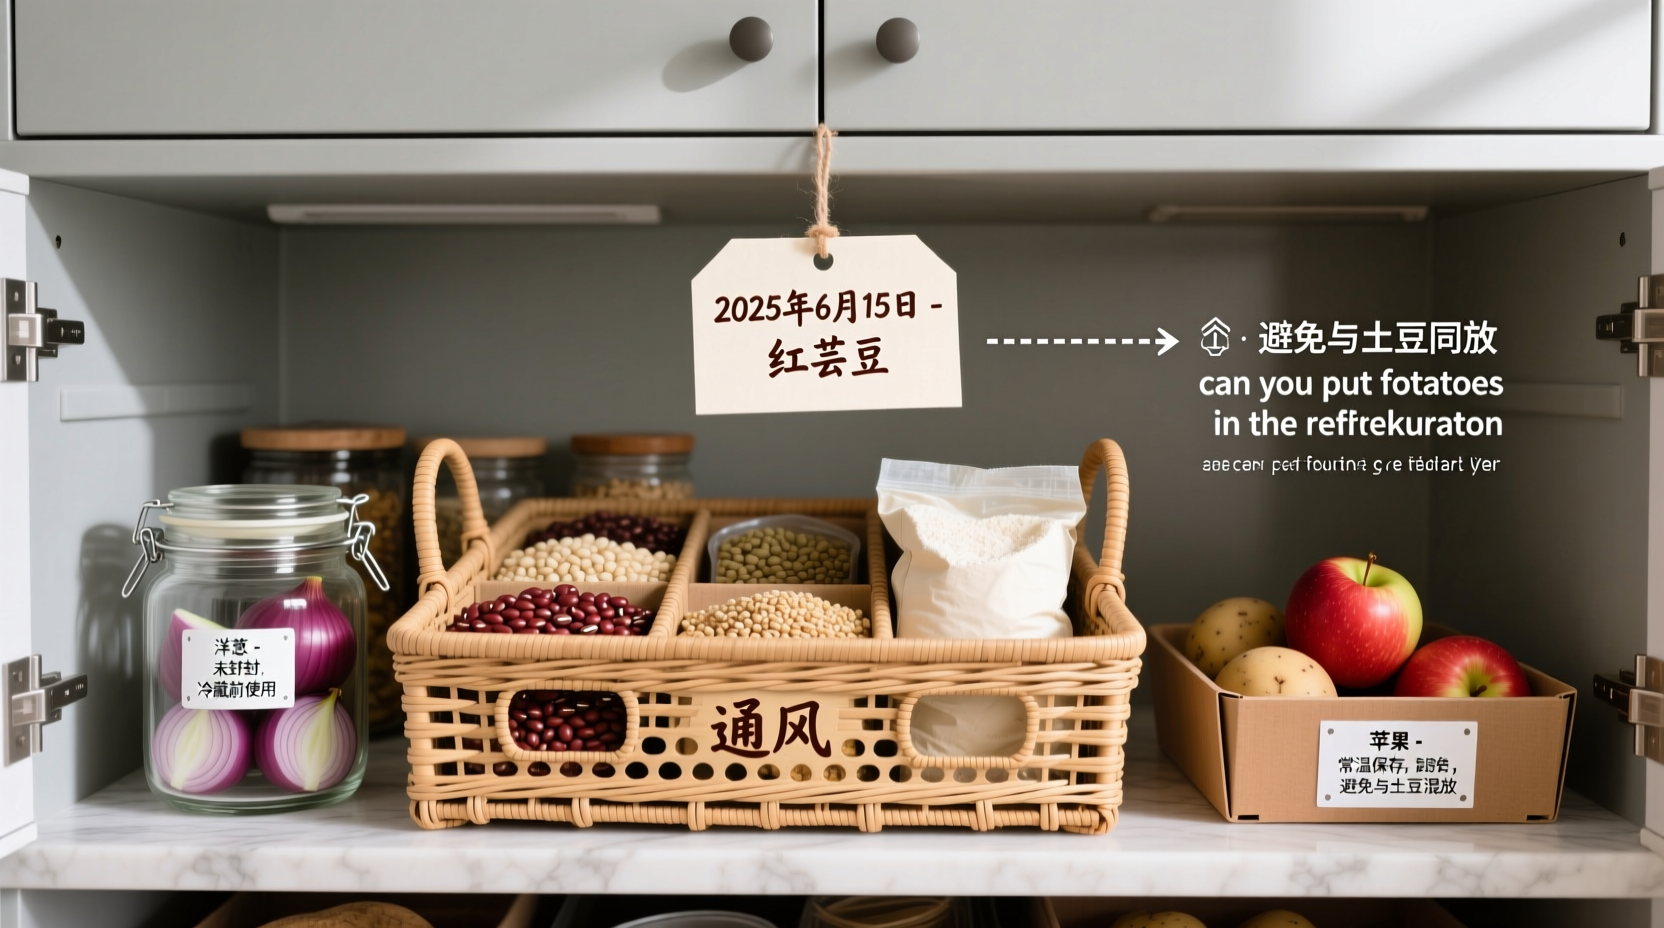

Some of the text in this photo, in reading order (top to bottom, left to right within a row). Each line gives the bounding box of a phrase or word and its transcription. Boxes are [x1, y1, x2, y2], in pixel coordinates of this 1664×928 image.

[713, 289, 916, 328] 2025年6月15日
[768, 335, 889, 378] 红芸豆
[711, 697, 831, 758] 通风
[1369, 729, 1410, 752] 苹果
